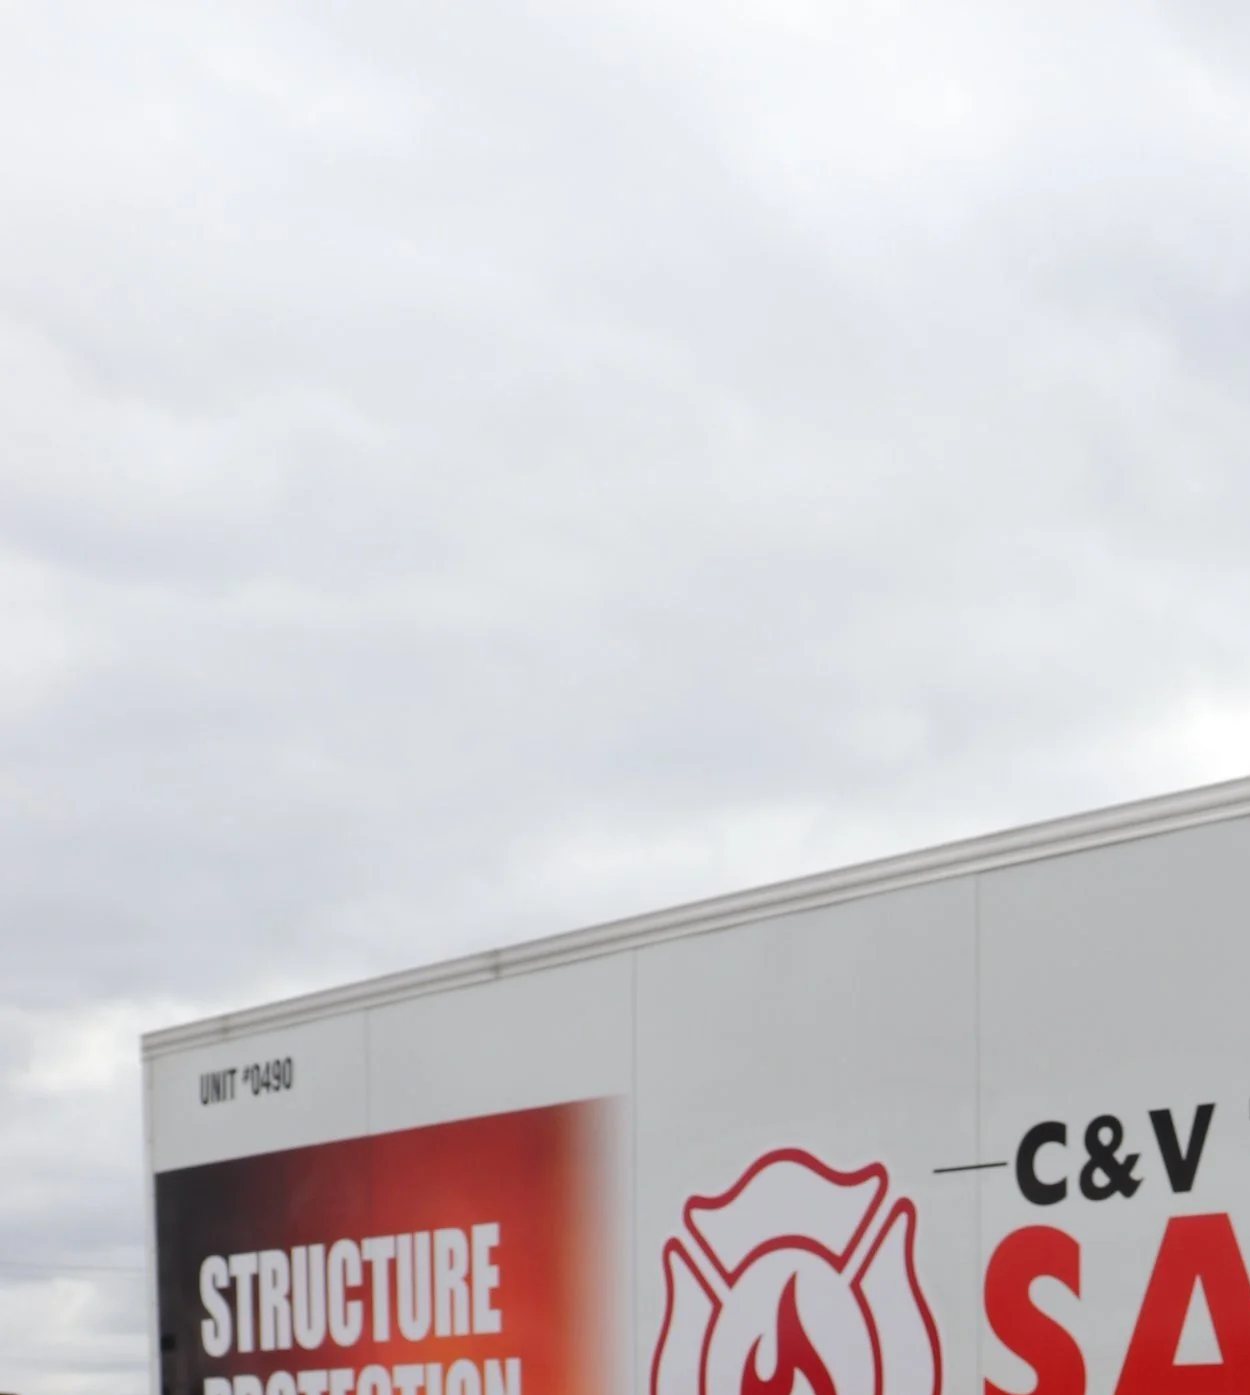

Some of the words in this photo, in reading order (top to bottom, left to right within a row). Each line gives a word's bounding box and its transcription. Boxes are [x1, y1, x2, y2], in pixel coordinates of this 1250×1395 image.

[200, 1067, 237, 1106] UNIT
[1015, 1103, 1215, 1206] C&V
[200, 1222, 502, 1357] STRUCTURE
